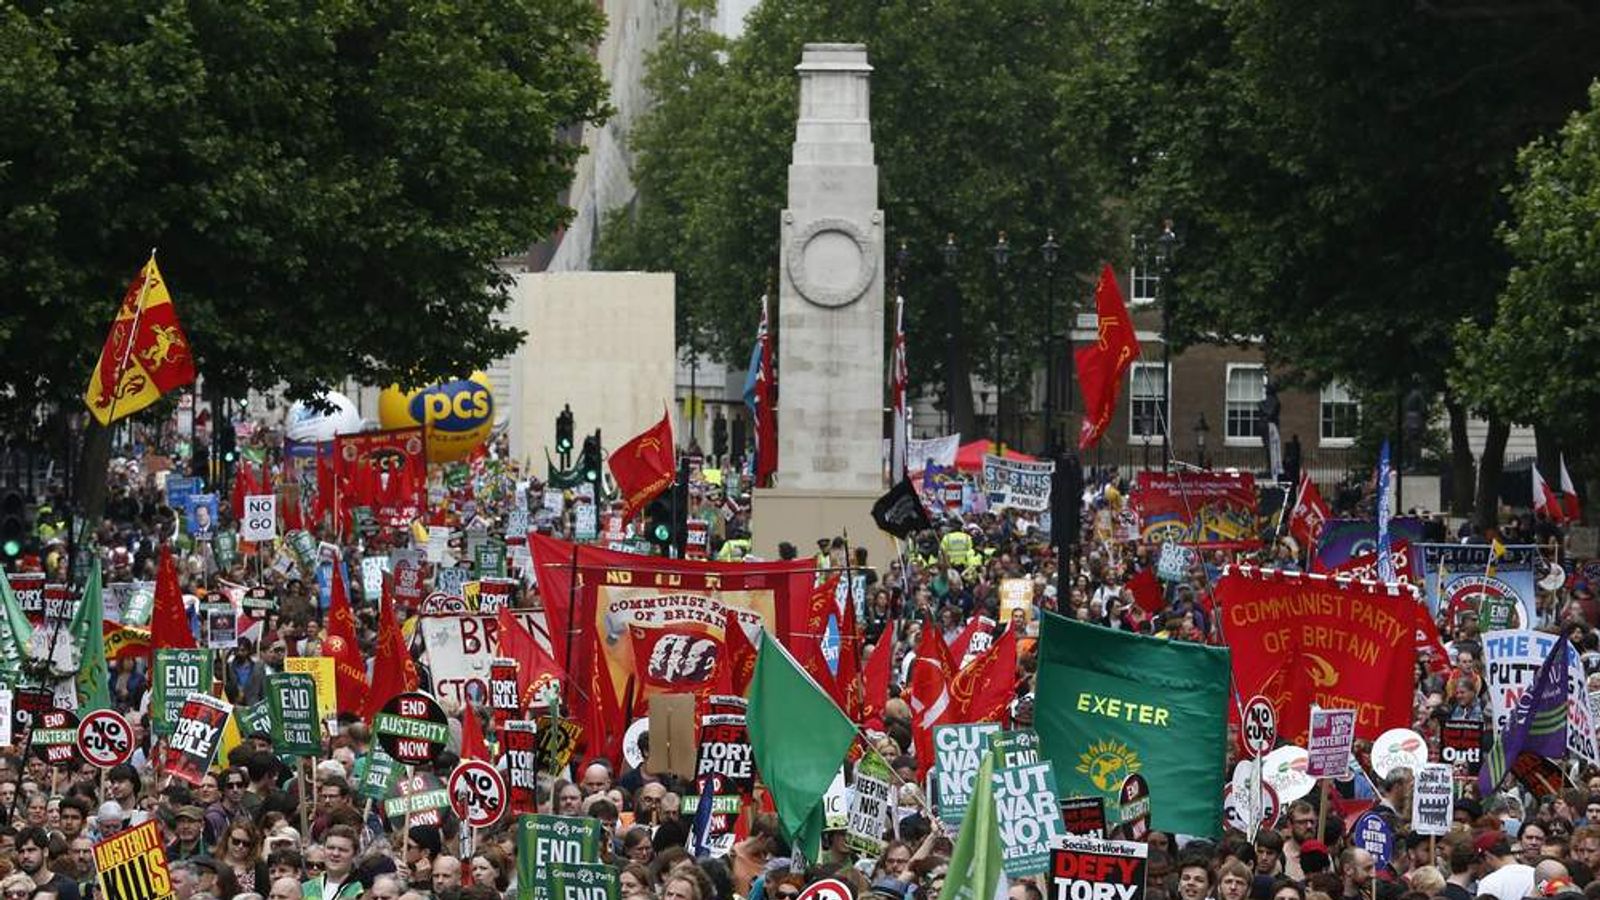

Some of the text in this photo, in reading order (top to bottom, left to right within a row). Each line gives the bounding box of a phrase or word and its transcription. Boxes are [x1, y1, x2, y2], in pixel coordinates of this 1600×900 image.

[424, 390, 489, 428] pcs
[250, 501, 272, 512] NO
[250, 518, 272, 529] GO
[1426, 547, 1530, 564] Hariney
[16, 589, 43, 601] ORY
[609, 596, 706, 613] COMMUNIST
[634, 608, 728, 629] OF BRITAIN
[1230, 593, 1409, 648] COMMUNIST PARTY
[1263, 625, 1381, 667] OF BRITAIN
[1486, 635, 1530, 660] THE
[165, 665, 199, 688] END
[491, 679, 518, 694] TORY
[280, 688, 310, 710] END
[400, 700, 426, 716] END
[492, 692, 519, 709] RULE
[1076, 692, 1169, 727] EXETER
[1250, 708, 1270, 723] NO
[43, 713, 65, 728] END
[91, 720, 121, 736] NO
[176, 717, 218, 742] TORY
[251, 715, 272, 734] EN
[379, 716, 447, 741] AUSTERITY
[31, 731, 77, 745] AUSTERIT
[296, 731, 313, 744] ALL
[936, 725, 1000, 751] CUT
[1247, 725, 1275, 740] CUTS
[47, 746, 72, 761] NOW
[83, 736, 128, 753] CUTS
[171, 732, 212, 759] RULE
[397, 741, 429, 757] NOW
[700, 742, 752, 760] TORY
[938, 751, 982, 771] WA
[1441, 746, 1480, 763] Out!
[699, 759, 752, 778] RULE
[399, 776, 424, 795] ED
[698, 778, 722, 794] ED
[856, 776, 876, 797] KEEP
[940, 771, 980, 795] NO
[683, 796, 739, 812] AUERITY
[859, 796, 880, 818] NHS
[526, 820, 594, 836] Green Party
[999, 815, 1063, 847] NOT
[97, 821, 160, 871] AUSTERITY
[536, 838, 581, 866] END
[1062, 838, 1137, 856] Socialist Worker
[101, 847, 173, 900] KILLS
[552, 869, 576, 879] Green
[595, 870, 616, 885] Party
[1054, 853, 1141, 885] DEFY
[1053, 876, 1138, 900] TORY
